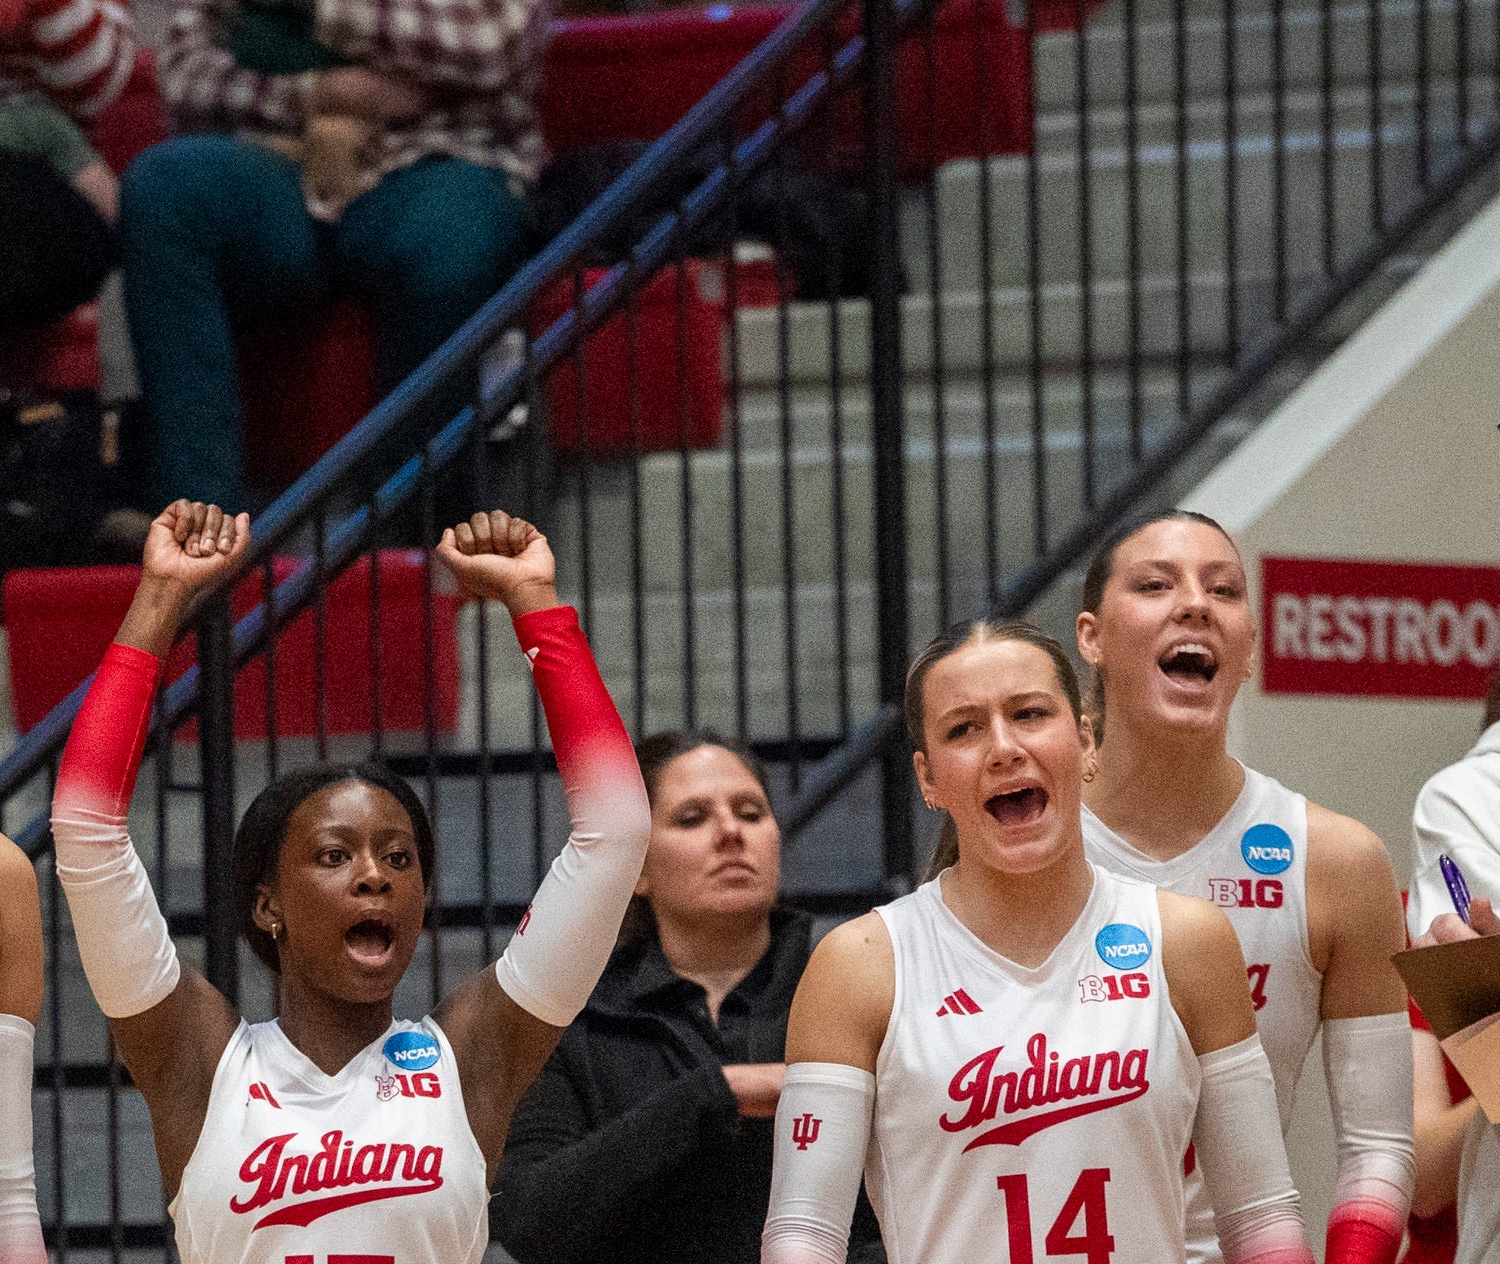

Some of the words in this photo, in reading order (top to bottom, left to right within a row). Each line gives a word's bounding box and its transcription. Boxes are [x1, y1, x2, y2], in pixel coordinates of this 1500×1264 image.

[1273, 591, 1500, 667] RESTROO
[1247, 846, 1291, 862] NCAA
[1105, 943, 1149, 959] NCAA
[394, 1046, 438, 1062] NCAA
[939, 1032, 1150, 1133] Indiana
[230, 1130, 444, 1215] Indiana
